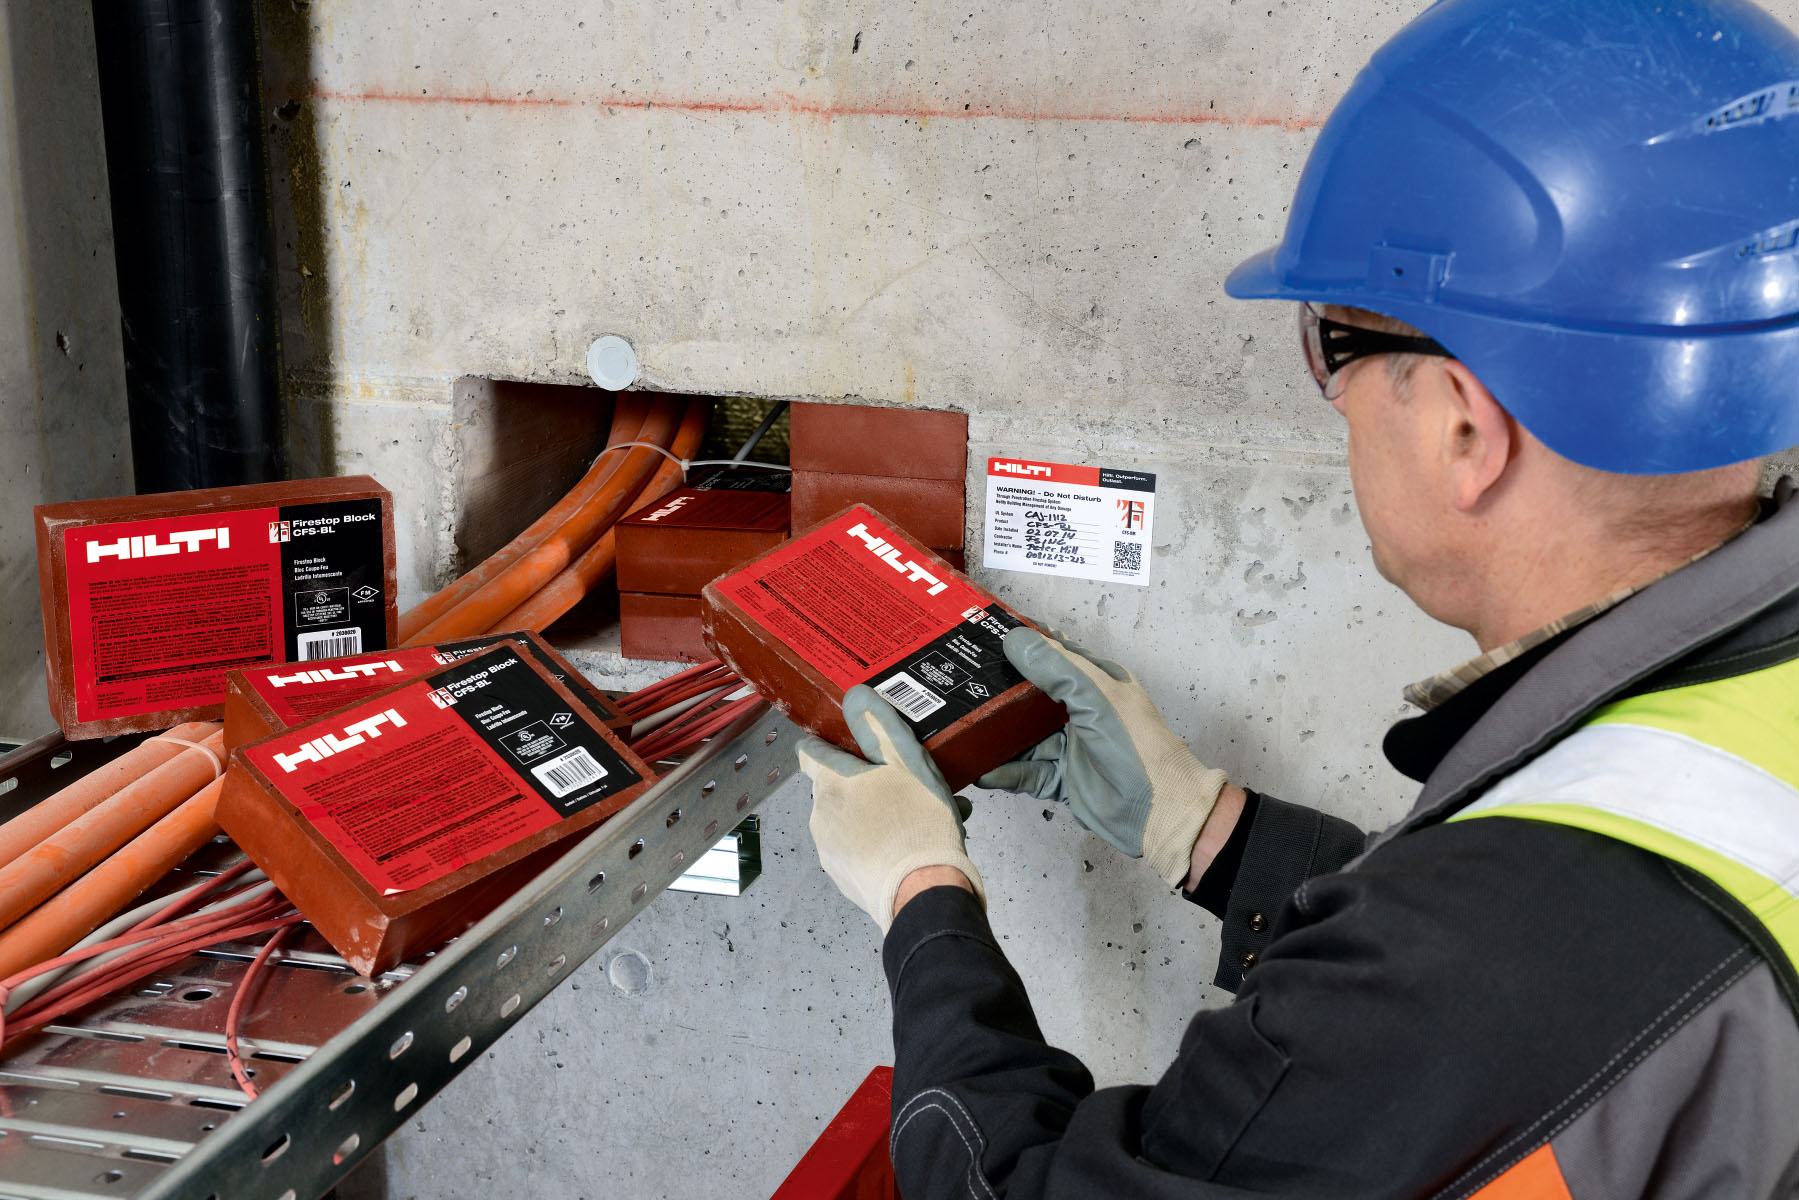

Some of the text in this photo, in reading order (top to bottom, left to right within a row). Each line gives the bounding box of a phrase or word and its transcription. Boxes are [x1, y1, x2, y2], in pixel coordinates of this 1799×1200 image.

[994, 462, 1051, 477] HILTI
[996, 486, 1035, 496] WARNING!
[1073, 494, 1102, 503] Disturb
[292, 513, 376, 528] Firestop Block
[1026, 521, 1077, 531] CFS-BL
[292, 526, 336, 537] CFS-BL
[1026, 528, 1041, 536] 02
[1062, 531, 1075, 539] 14
[86, 527, 230, 563] HILTI
[846, 522, 949, 597] HILTI
[267, 660, 404, 688] HILTI
[446, 658, 518, 691] Firestop Block
[453, 679, 492, 698] CFS-BL
[272, 708, 408, 774] HILTI
